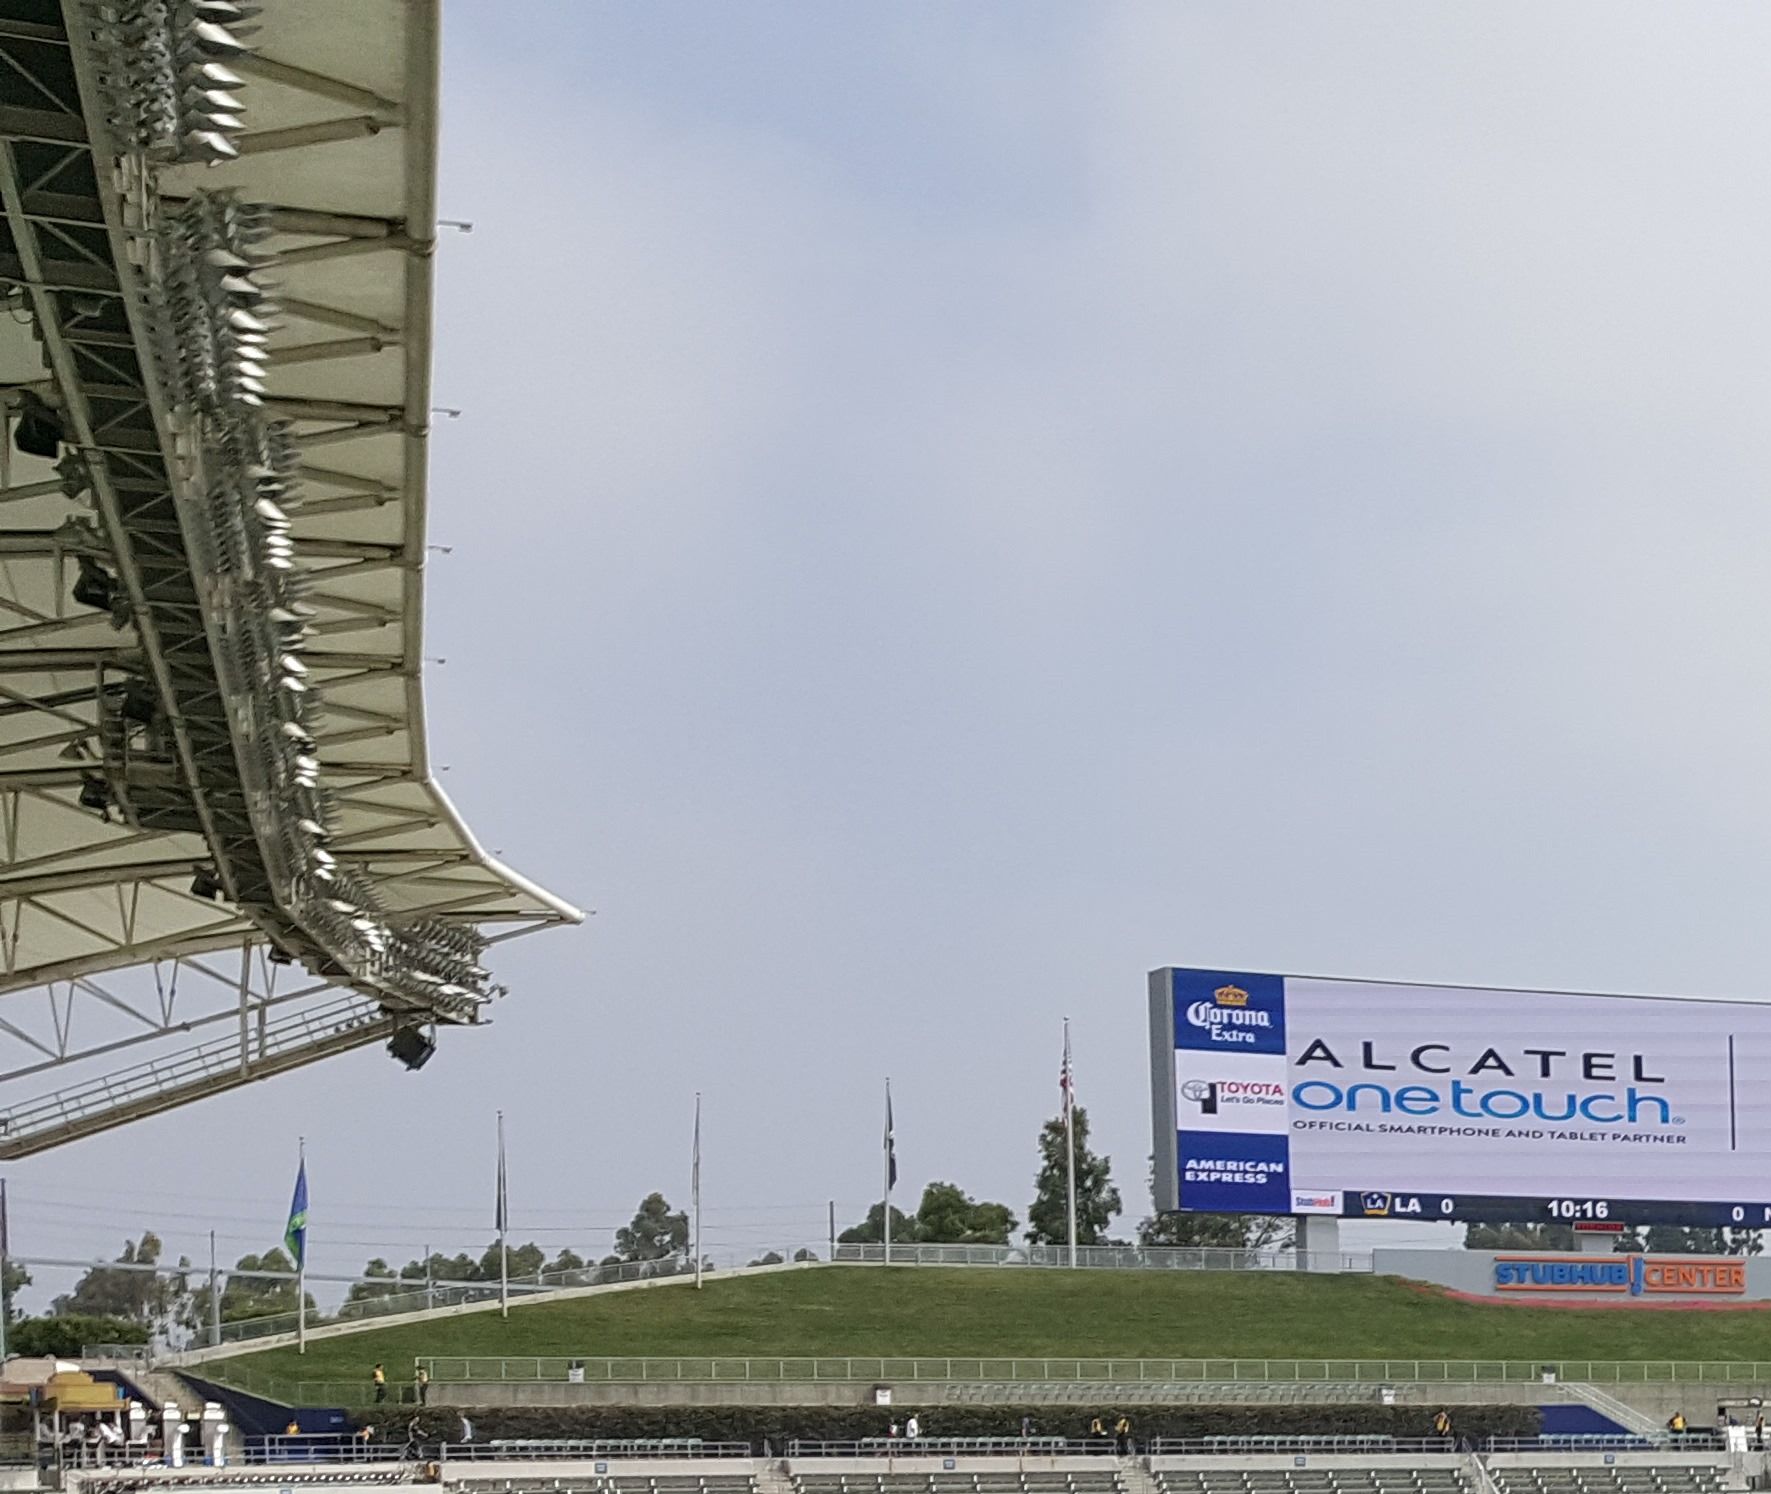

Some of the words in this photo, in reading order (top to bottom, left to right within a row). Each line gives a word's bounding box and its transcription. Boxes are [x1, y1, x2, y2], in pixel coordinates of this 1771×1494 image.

[1187, 1002, 1270, 1028] Corona
[1211, 1025, 1255, 1043] Extra
[1294, 1038, 1665, 1083] ALCATEL
[1217, 1082, 1284, 1097] TOYOTA
[1293, 1119, 1375, 1133] OFFICIAL
[1378, 1123, 1501, 1139] SMARTPHONE
[1505, 1128, 1543, 1140] AND
[1547, 1129, 1607, 1142] TABLET
[1611, 1132, 1687, 1145] PARTNER
[1185, 1159, 1284, 1174] AMERICAN
[1185, 1171, 1268, 1184] EXPRESS
[1394, 1197, 1421, 1213] LA
[1440, 1198, 1453, 1214] 0
[1547, 1200, 1609, 1219] 10:16
[1731, 1206, 1745, 1222] 0
[1645, 1264, 1745, 1288] CENTER
